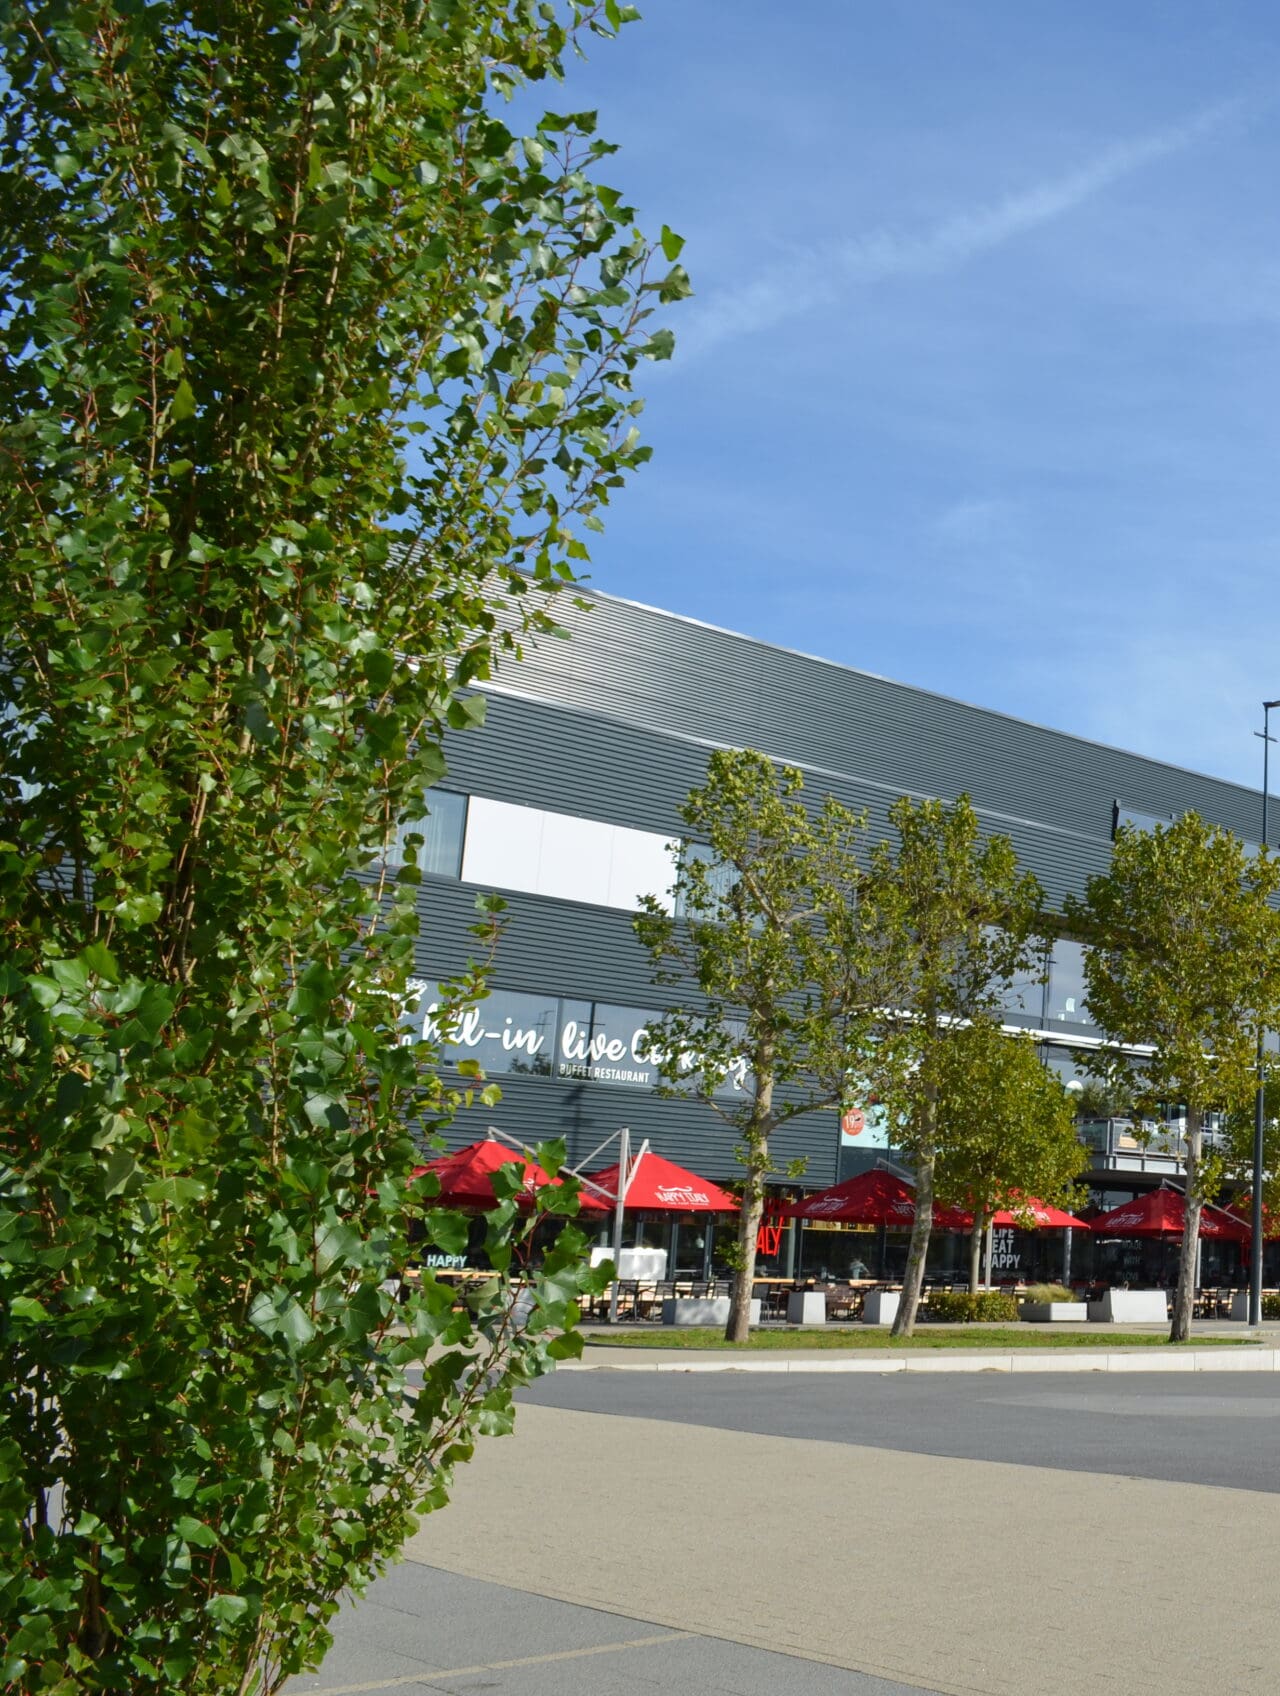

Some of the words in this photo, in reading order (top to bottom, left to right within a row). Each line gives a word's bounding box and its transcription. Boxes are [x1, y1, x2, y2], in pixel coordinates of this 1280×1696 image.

[562, 1020, 627, 1062] live
[559, 1063, 592, 1078] BUFFET
[594, 1067, 650, 1083] RESTAURANT
[756, 1216, 784, 1257] ALY
[992, 1240, 1014, 1254] EAT
[426, 1254, 468, 1268] HAPPY
